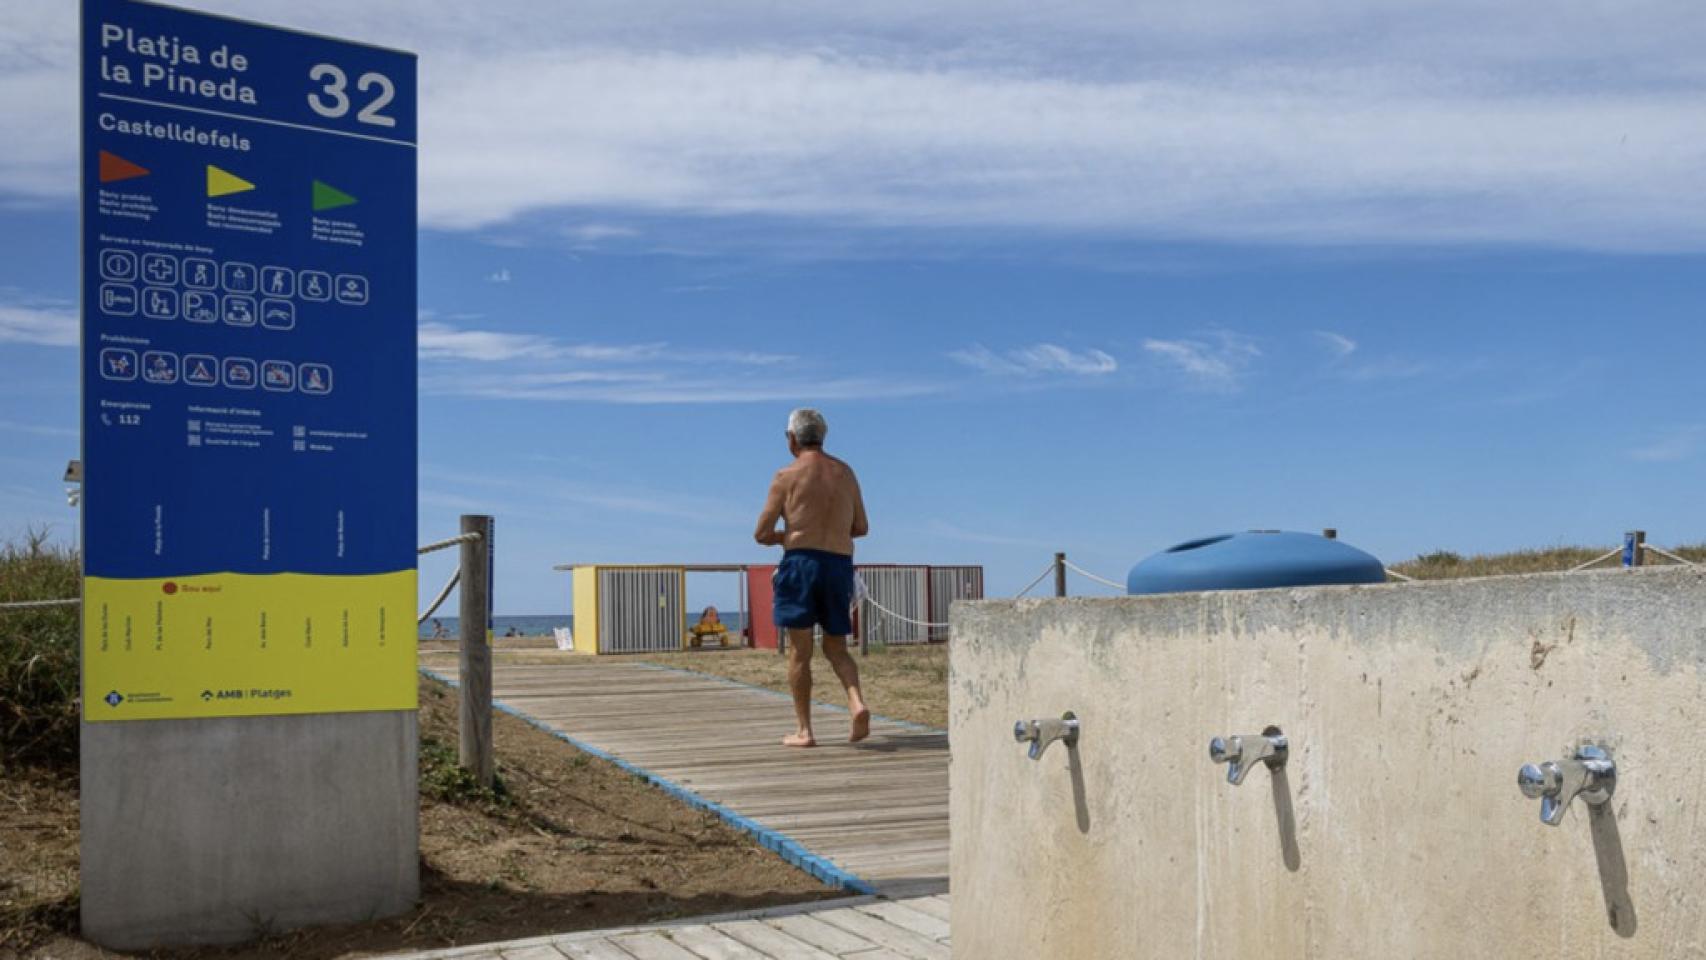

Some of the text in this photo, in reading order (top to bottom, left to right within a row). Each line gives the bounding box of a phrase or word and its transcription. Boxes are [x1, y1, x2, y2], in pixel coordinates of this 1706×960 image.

[102, 24, 248, 71] Platja de
[101, 55, 257, 105] la Pineda
[307, 63, 396, 127] 32
[99, 113, 250, 152] Castelldefels
[119, 414, 141, 426] 112
[216, 687, 292, 701] AMB Platges
